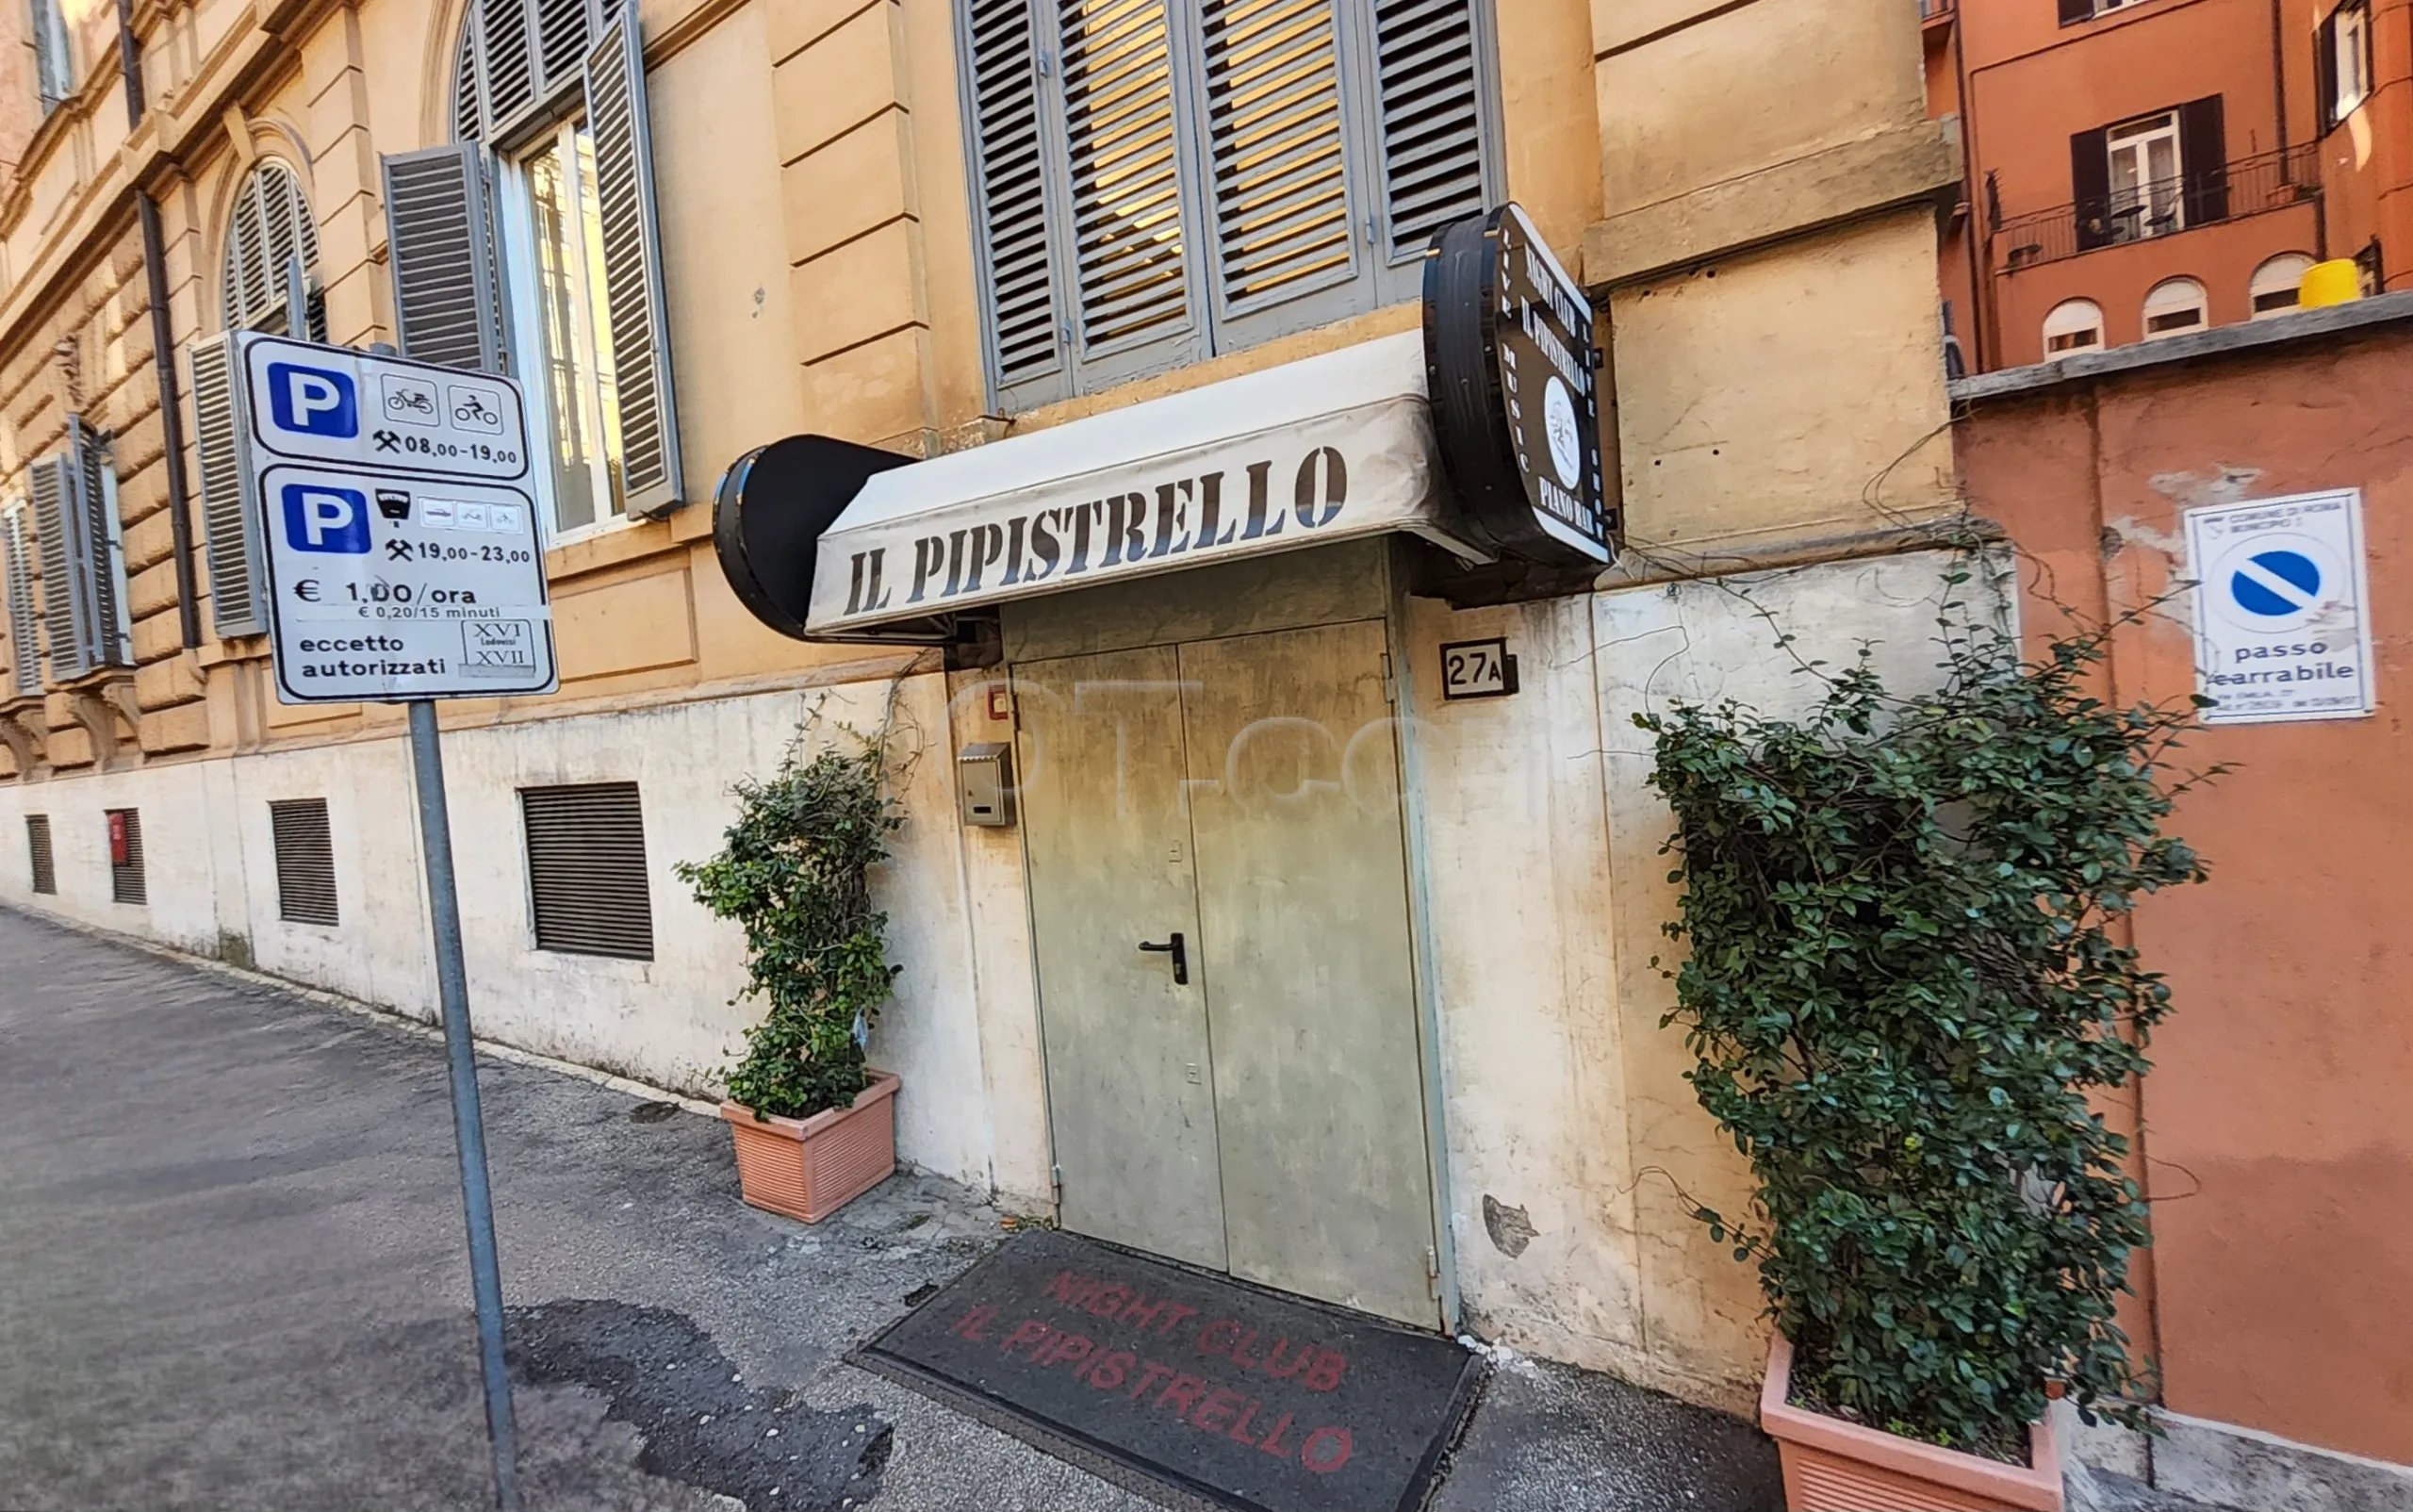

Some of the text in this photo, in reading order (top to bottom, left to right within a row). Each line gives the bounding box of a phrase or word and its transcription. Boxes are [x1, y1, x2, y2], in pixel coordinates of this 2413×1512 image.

[1524, 241, 1577, 338] NIGHT CLUB
[1520, 295, 1586, 397] IL PIPISTRELLO
[288, 371, 340, 426] P
[1502, 342, 1530, 472] MUSIC
[302, 492, 354, 546] P
[1538, 475, 1595, 534] PIANO BAR
[1590, 448, 1604, 540] SHOW
[844, 445, 1348, 616] IL PIPISTRELLO
[293, 579, 321, 603] €
[376, 606, 440, 620] 0,20/15
[446, 606, 501, 618] minuti
[300, 635, 404, 652] eccetto
[473, 623, 521, 637] XVI
[2235, 641, 2328, 663] passo
[302, 658, 446, 678] autorizzati
[476, 650, 525, 666] XVII
[2214, 662, 2355, 685] carrabile
[1046, 1270, 1349, 1393] NIGHT CLUB
[951, 1304, 1354, 1474] IL PIPISTRELLO
